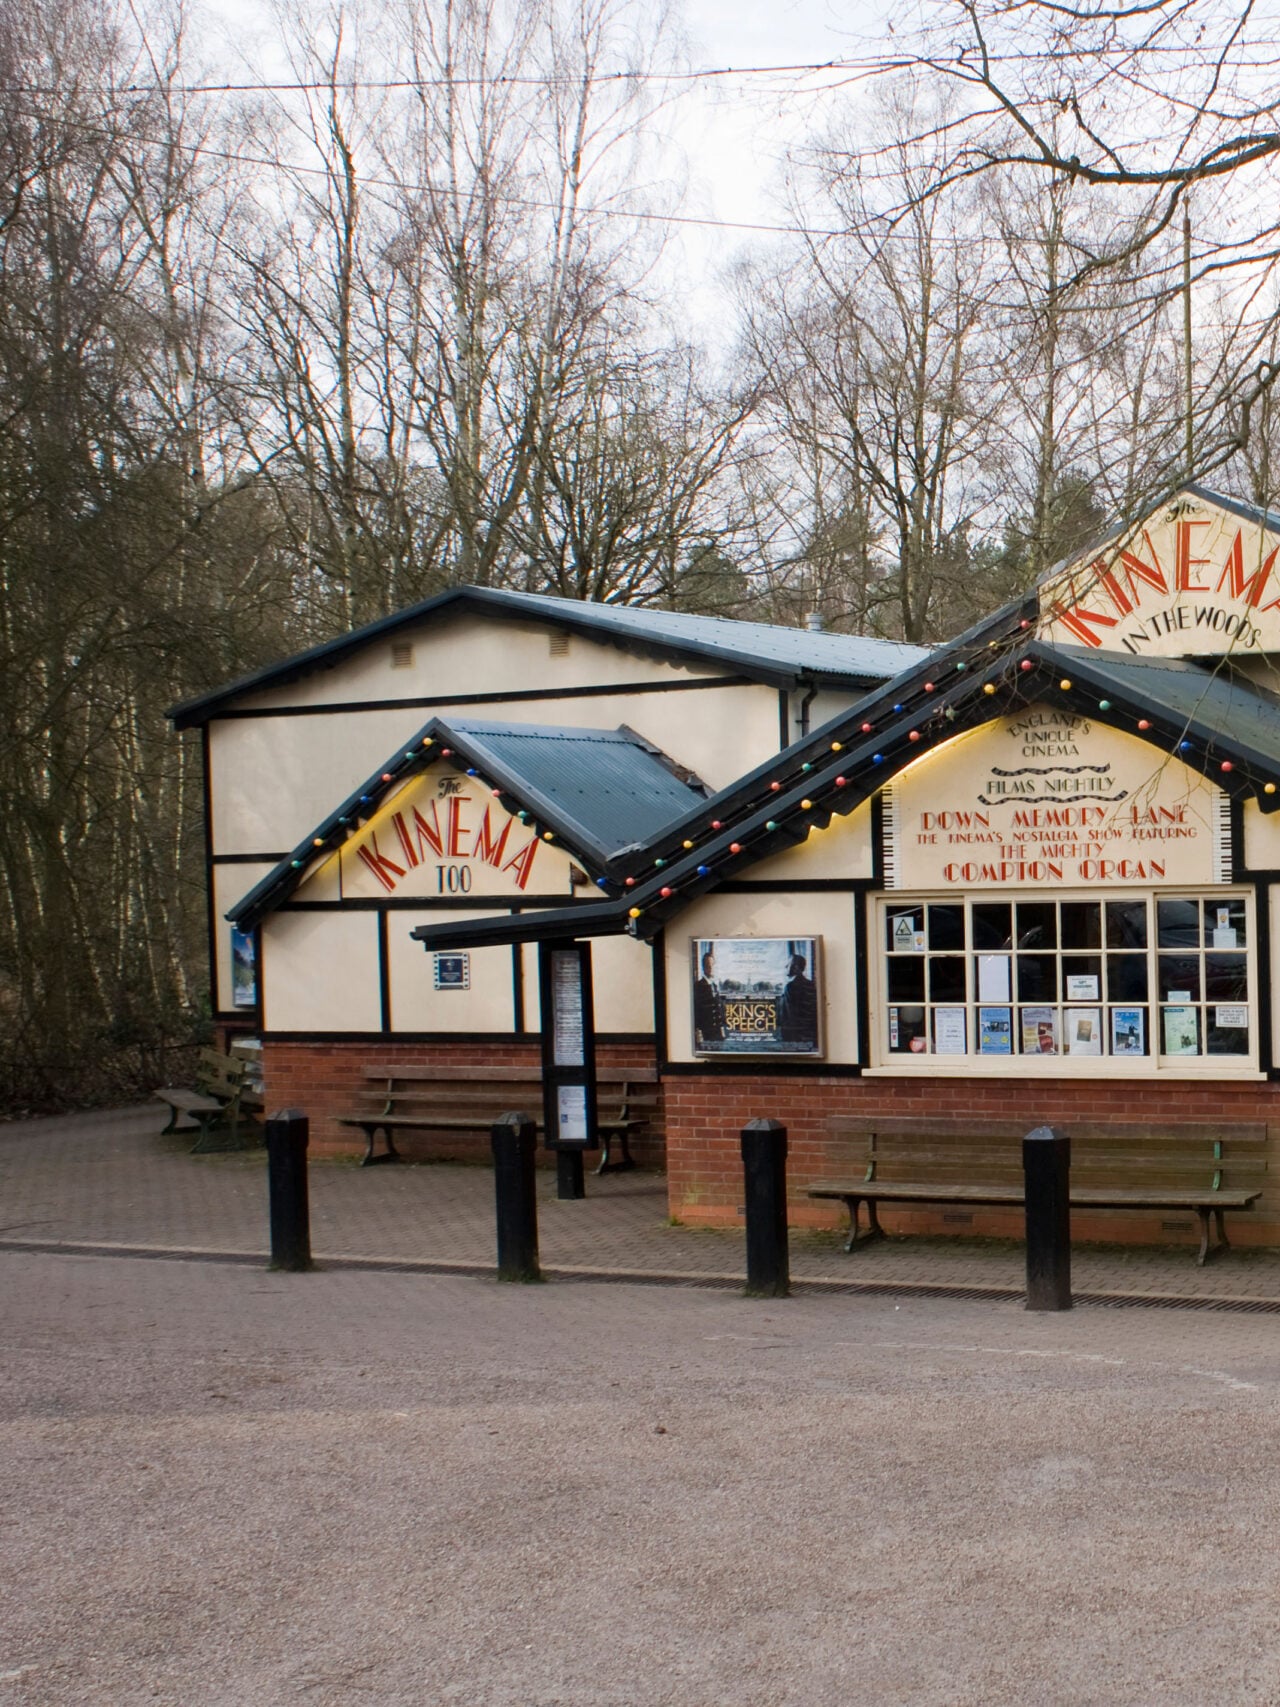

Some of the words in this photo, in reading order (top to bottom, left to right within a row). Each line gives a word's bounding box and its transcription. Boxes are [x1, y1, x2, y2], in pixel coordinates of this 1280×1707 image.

[1121, 624, 1151, 655] IN
[1146, 606, 1192, 637] THE
[1194, 605, 1262, 649] WOODS
[1024, 730, 1075, 744] UNIQUE
[1021, 744, 1080, 758] CINEMA
[437, 776, 464, 799] The
[986, 779, 1036, 795] FILMS
[1044, 777, 1116, 793] NIGHTLY
[920, 809, 990, 831] DOWN
[1010, 806, 1109, 829] MEMORY
[1130, 804, 1189, 825] LANE
[356, 796, 541, 893] KINEMA
[917, 833, 938, 845] THE
[948, 831, 1003, 844] KINEMA'S
[1012, 830, 1079, 843] NOSTALGIA
[1088, 828, 1123, 841] SHOW
[1132, 826, 1198, 840] FEATURING
[999, 844, 1028, 860] THE
[1039, 843, 1106, 859] MIGHTY
[436, 864, 472, 894] TOO
[943, 860, 1064, 882] COMPTON
[1078, 858, 1166, 880] ORGAN
[726, 1017, 777, 1031] SPEECH
